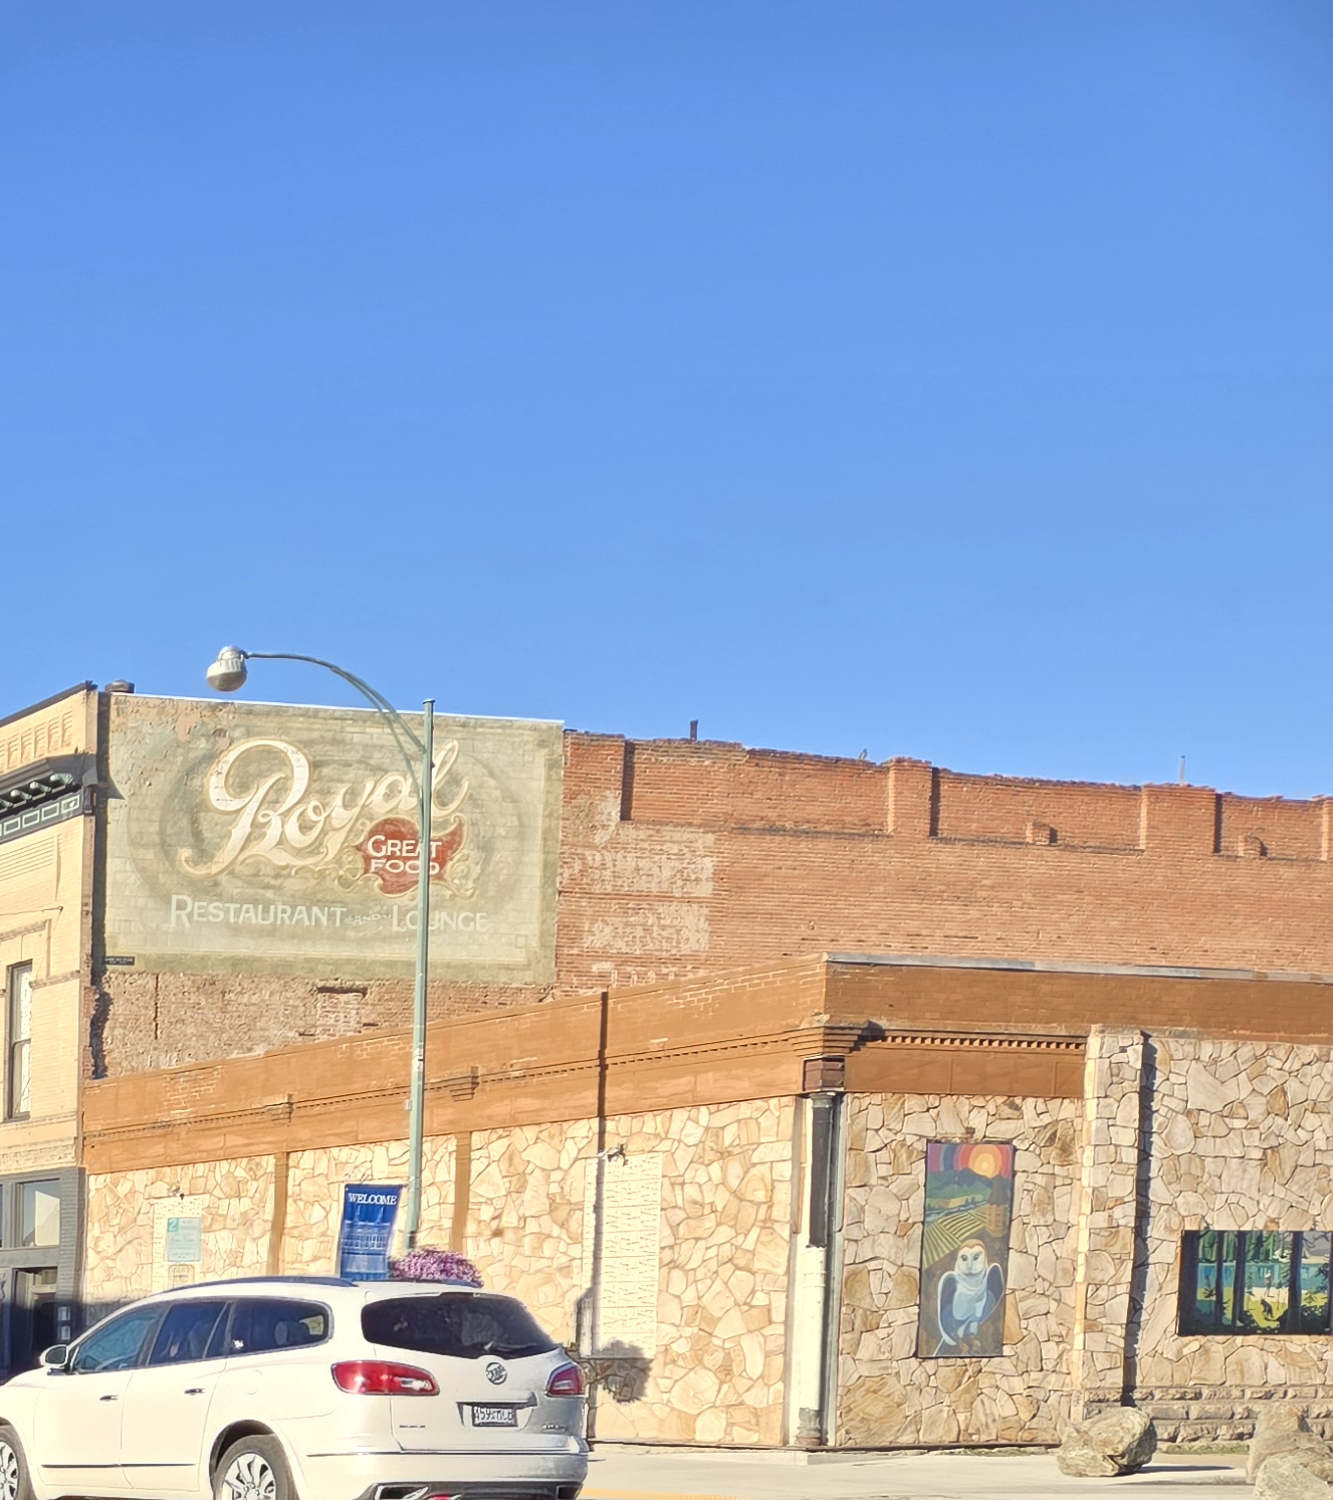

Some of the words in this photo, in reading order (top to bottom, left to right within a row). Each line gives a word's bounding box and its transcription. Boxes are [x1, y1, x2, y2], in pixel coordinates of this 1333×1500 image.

[178, 738, 470, 878] Royal
[370, 857, 440, 876] FOOD
[169, 895, 347, 930] RESTAURANT
[391, 904, 489, 932] LOUNGE
[348, 1192, 397, 1205] WELCOME
[169, 1219, 177, 1231] 2
